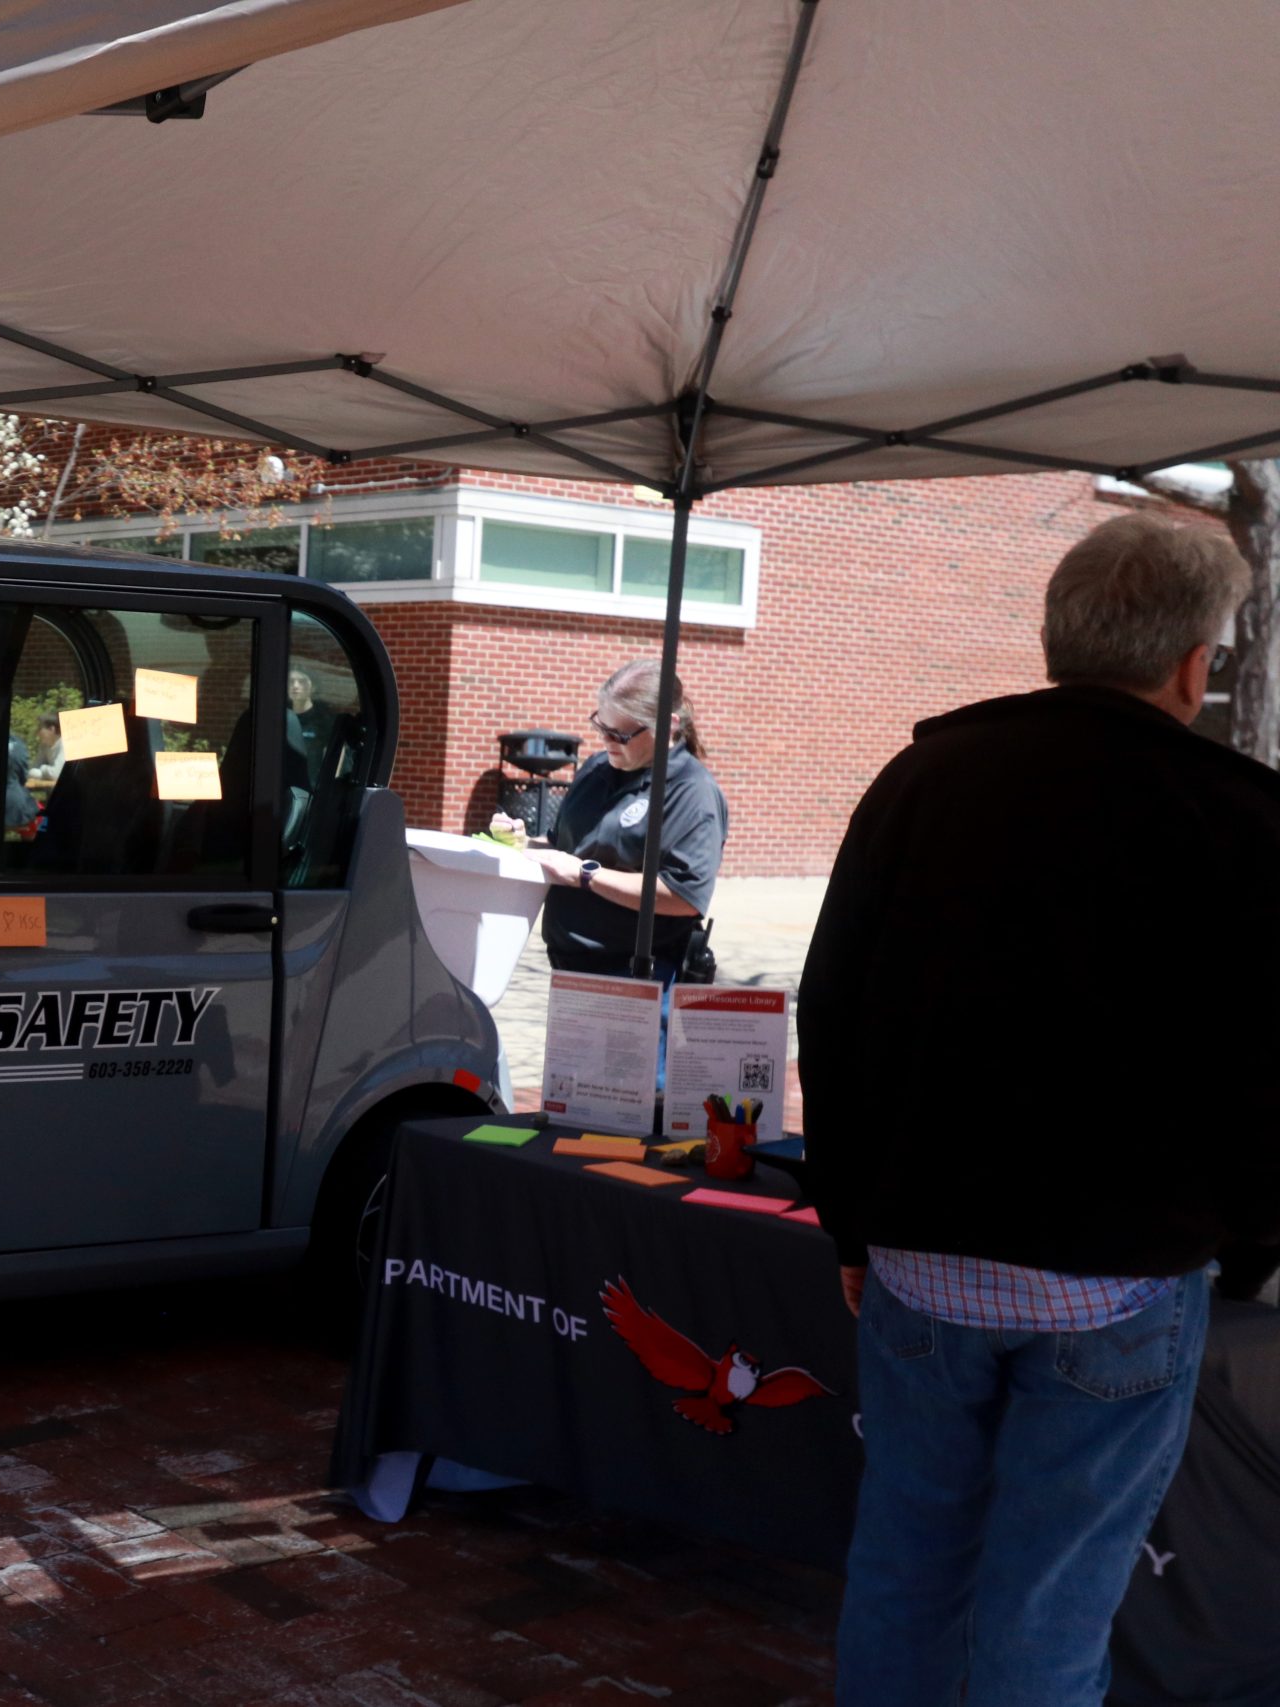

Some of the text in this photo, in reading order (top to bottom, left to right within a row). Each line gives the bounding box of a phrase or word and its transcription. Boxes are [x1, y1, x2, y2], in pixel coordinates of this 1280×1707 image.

[18, 912, 42, 931] KSC
[681, 992, 778, 1008] Virtual Resource Library
[88, 1058, 194, 1079] 603-358-2228
[382, 1258, 588, 1342] PARTMENT OF
